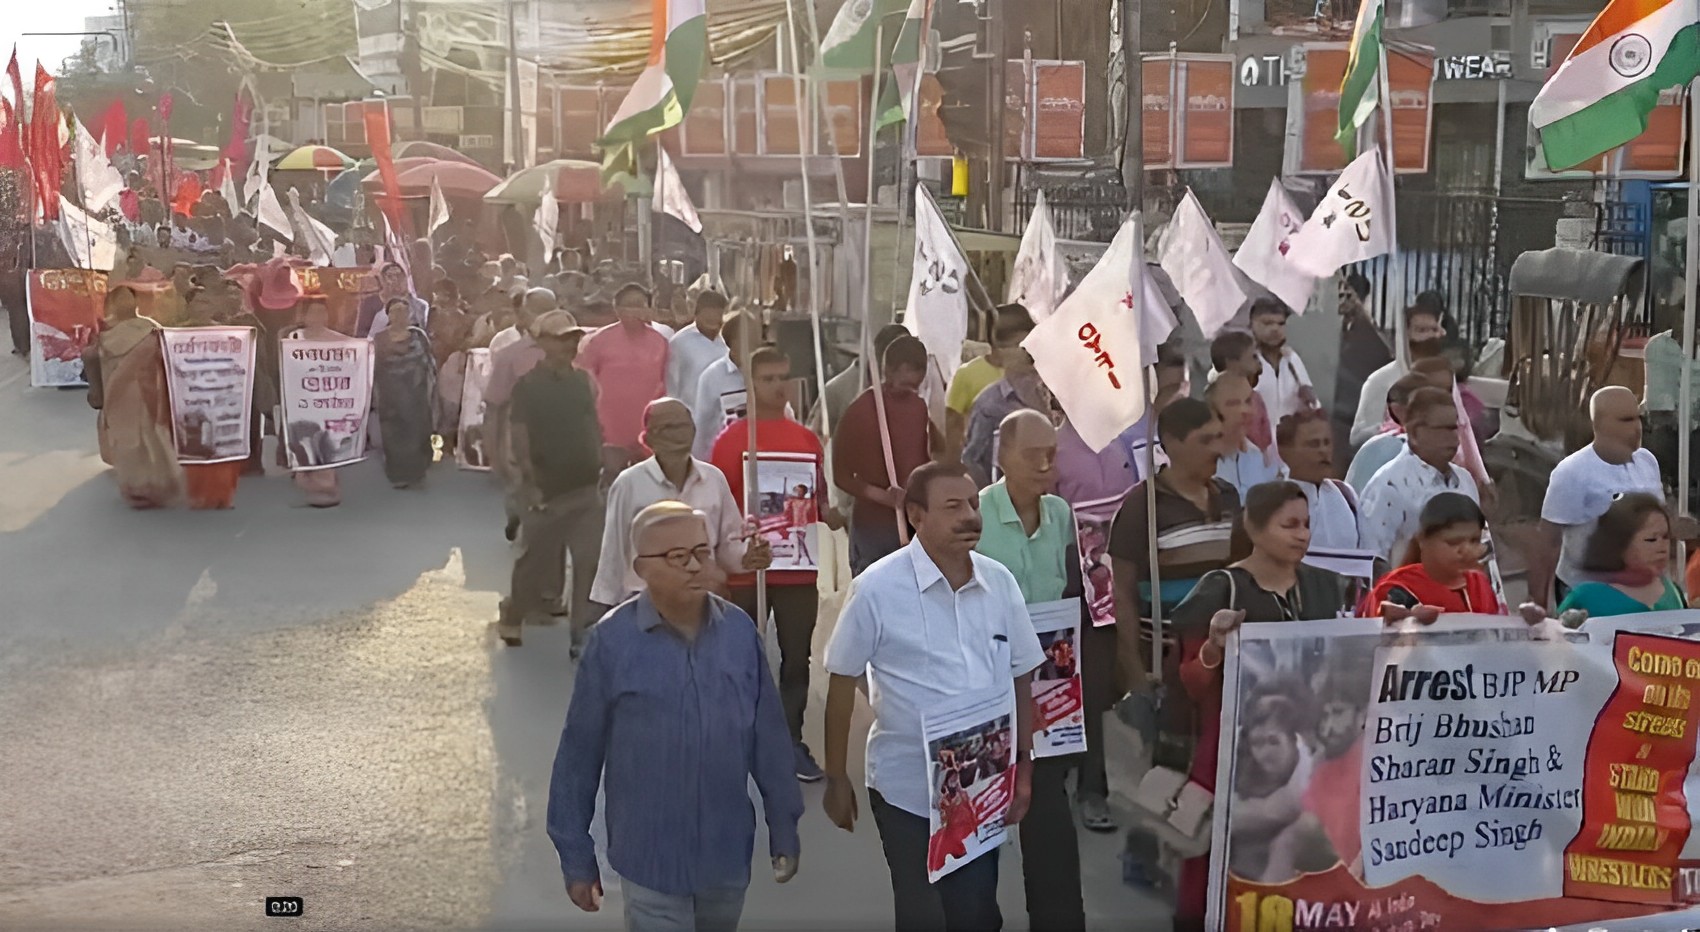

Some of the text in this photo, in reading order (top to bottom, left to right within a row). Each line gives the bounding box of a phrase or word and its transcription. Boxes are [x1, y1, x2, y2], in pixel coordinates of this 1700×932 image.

[1378, 664, 1580, 703] Arrest BJP MP
[1375, 711, 1535, 747] Brij Bhushan
[1370, 745, 1563, 783] Sharan Singh &
[1369, 784, 1580, 824] Haryana Minister
[1371, 818, 1542, 866] Sandeep Singh
[1295, 899, 1360, 928] MAY
